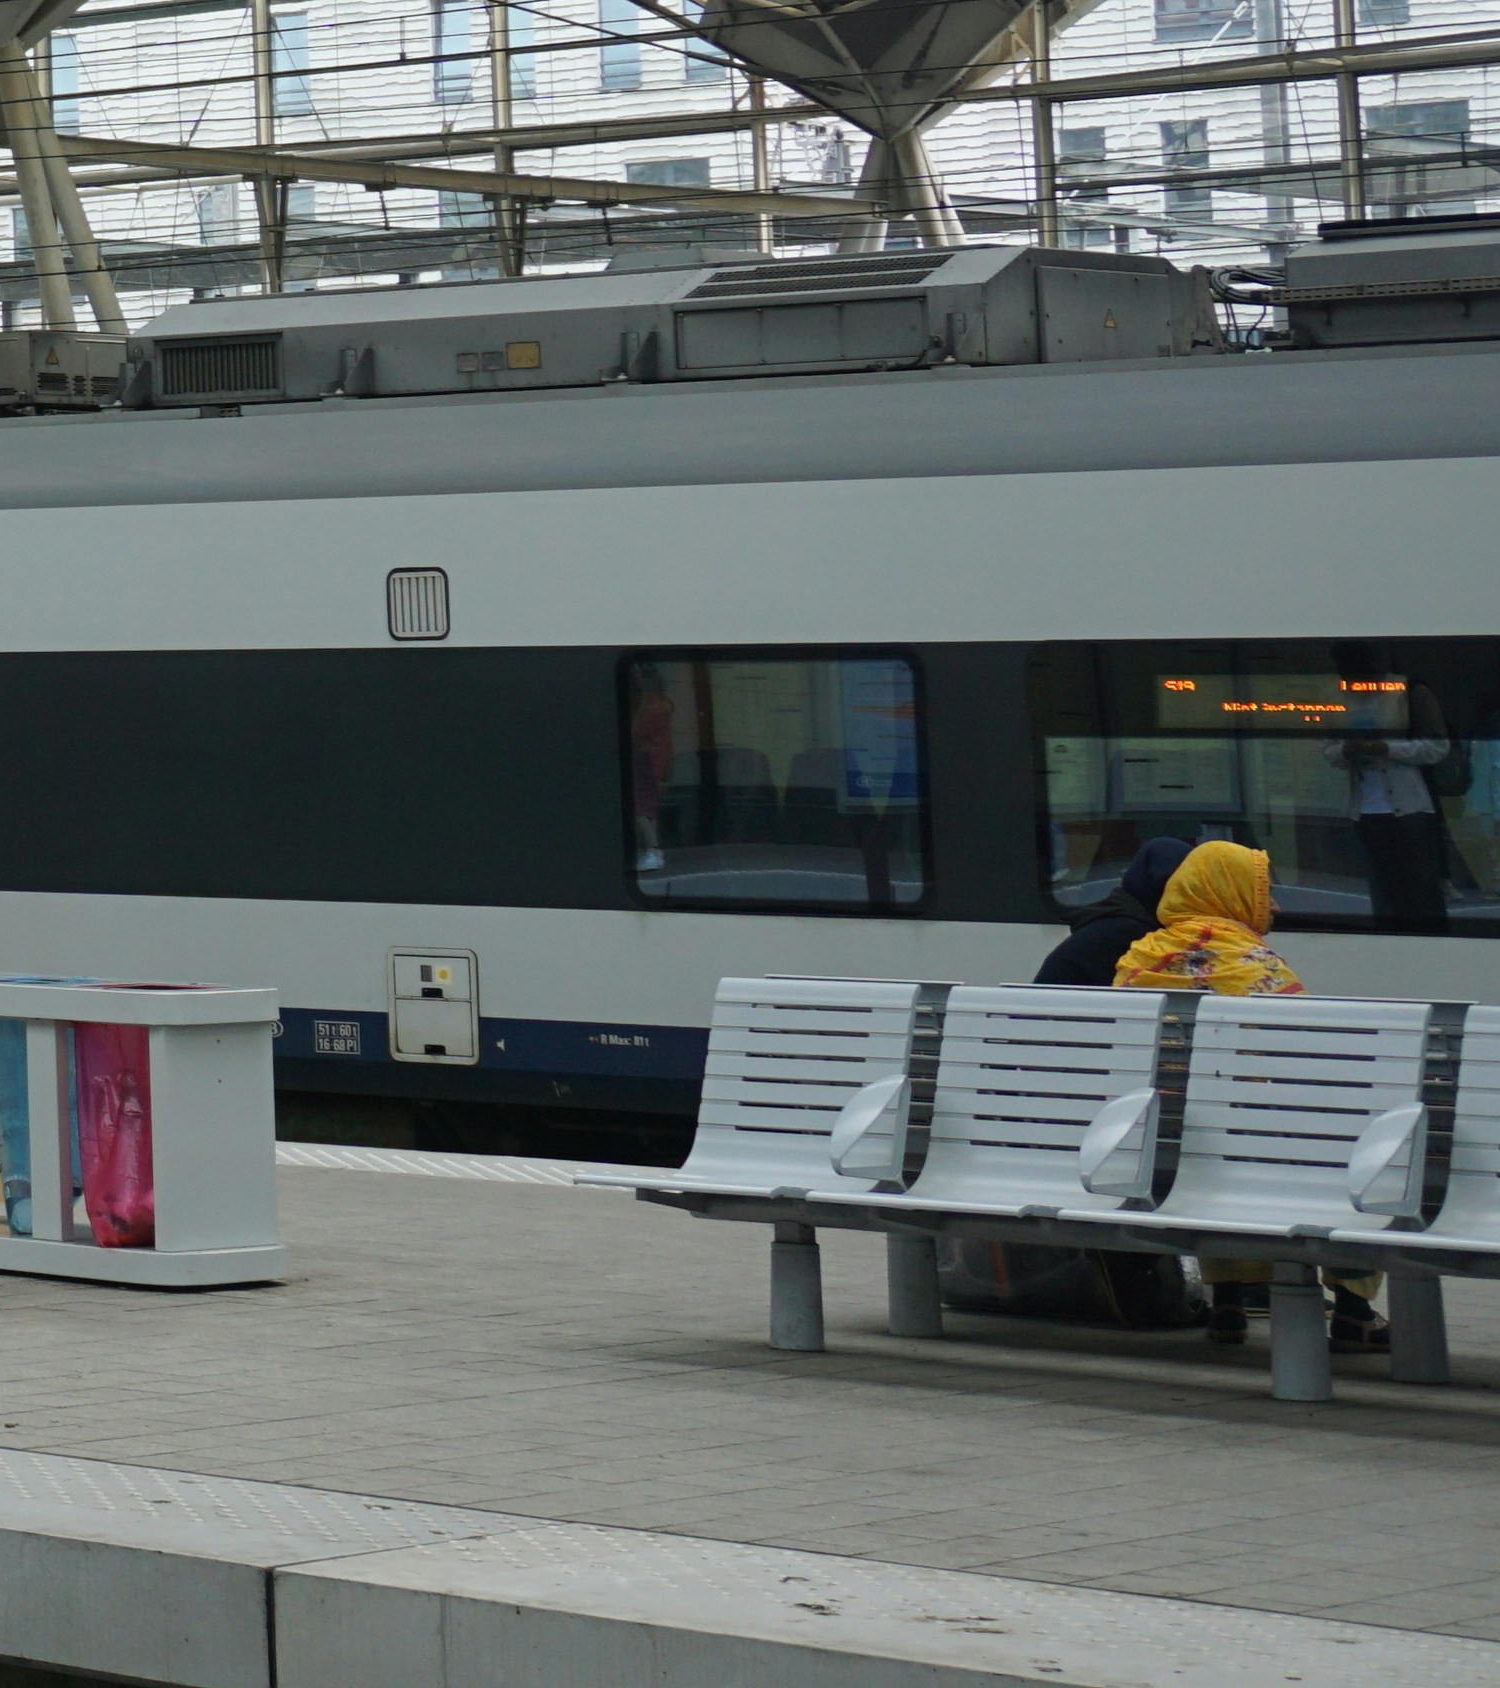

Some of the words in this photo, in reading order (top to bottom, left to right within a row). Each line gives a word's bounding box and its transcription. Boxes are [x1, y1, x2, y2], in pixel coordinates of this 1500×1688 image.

[318, 1024, 329, 1036] 51
[331, 1025, 336, 1036] t
[340, 1025, 351, 1036] 60
[352, 1026, 357, 1037] t
[318, 1038, 329, 1050] 16
